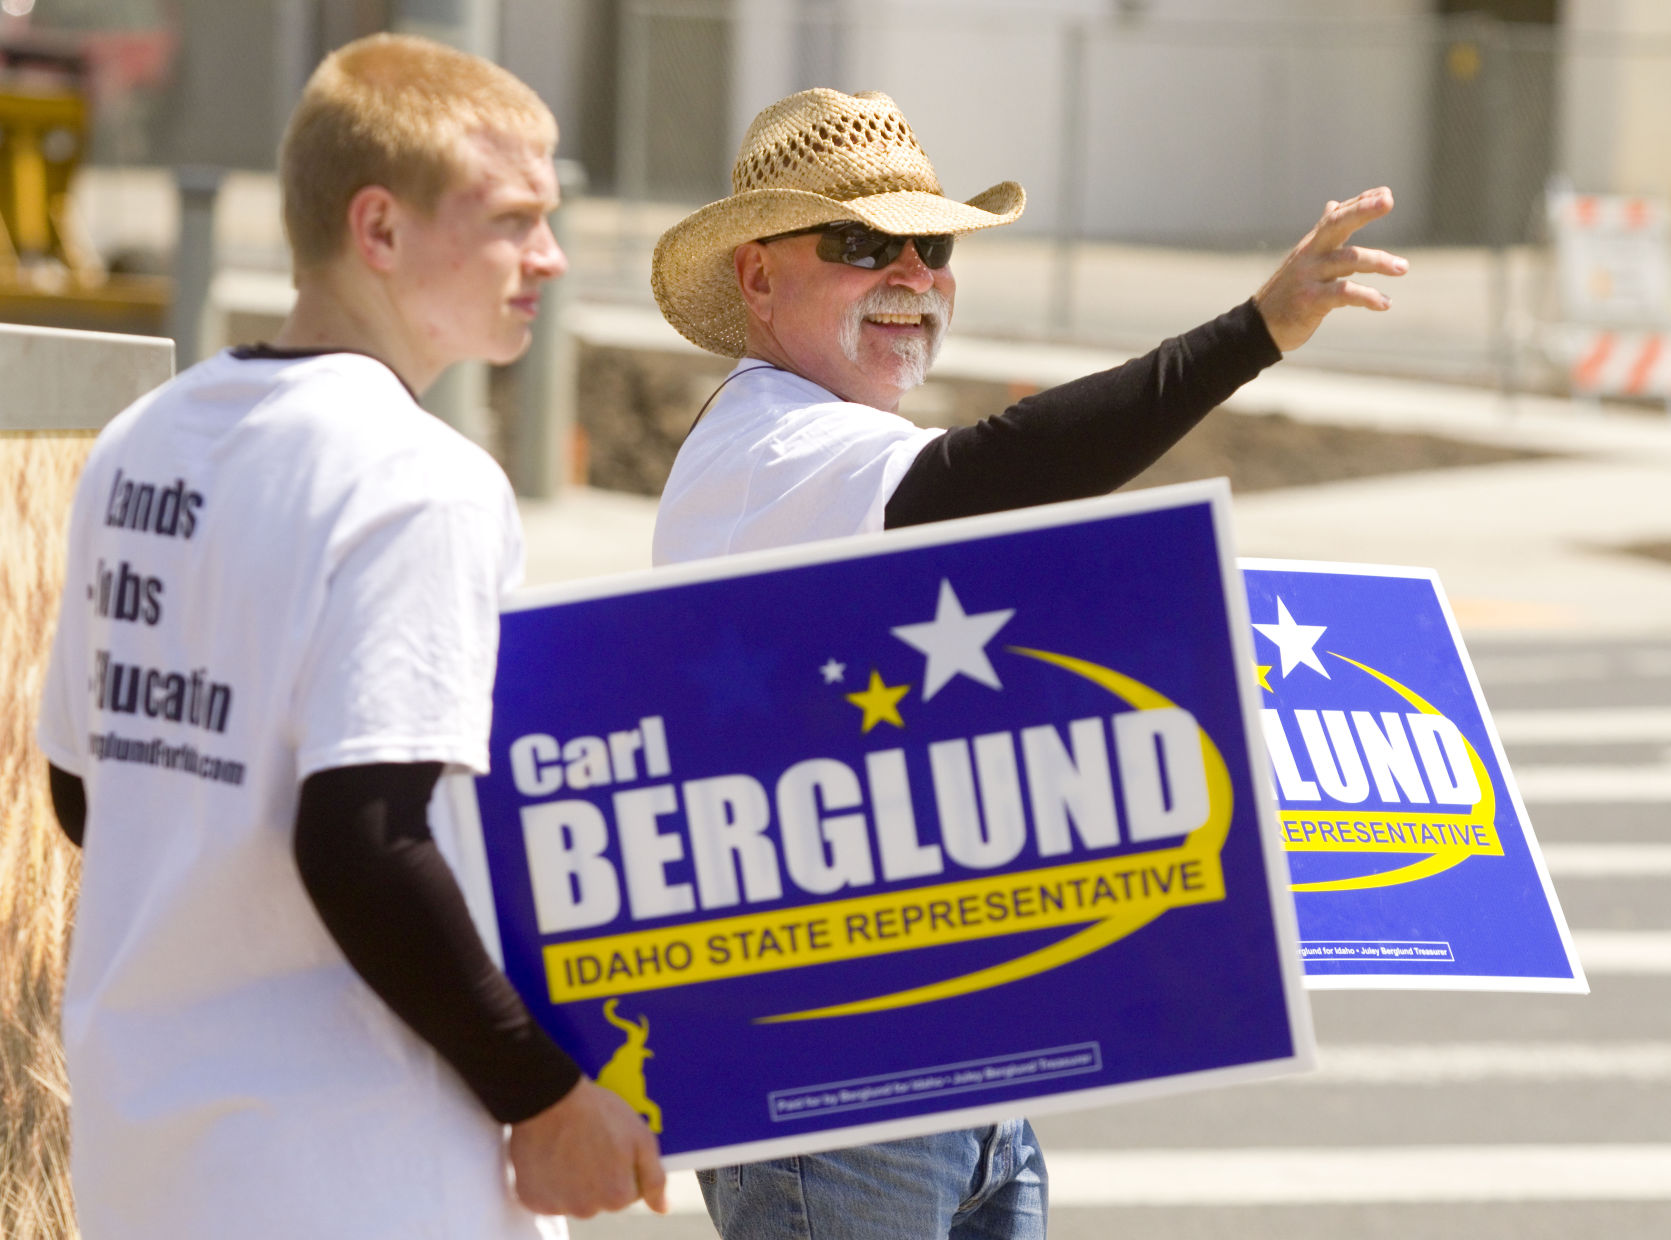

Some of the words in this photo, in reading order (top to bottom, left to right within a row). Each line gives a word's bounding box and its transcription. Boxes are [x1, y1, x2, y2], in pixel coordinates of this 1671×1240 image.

[509, 715, 671, 797] Carl
[1259, 708, 1482, 805] LUND
[520, 706, 1211, 935] BERGLUND
[1279, 820, 1491, 846] EPRESENTATIVE
[564, 941, 694, 988] IDAHO
[707, 917, 832, 966] STATE
[845, 859, 1206, 945] REPRESENTATIVE
[1335, 946, 1355, 955] Idaho
[1381, 946, 1414, 957] Berglund
[1414, 946, 1448, 956] Treasurer
